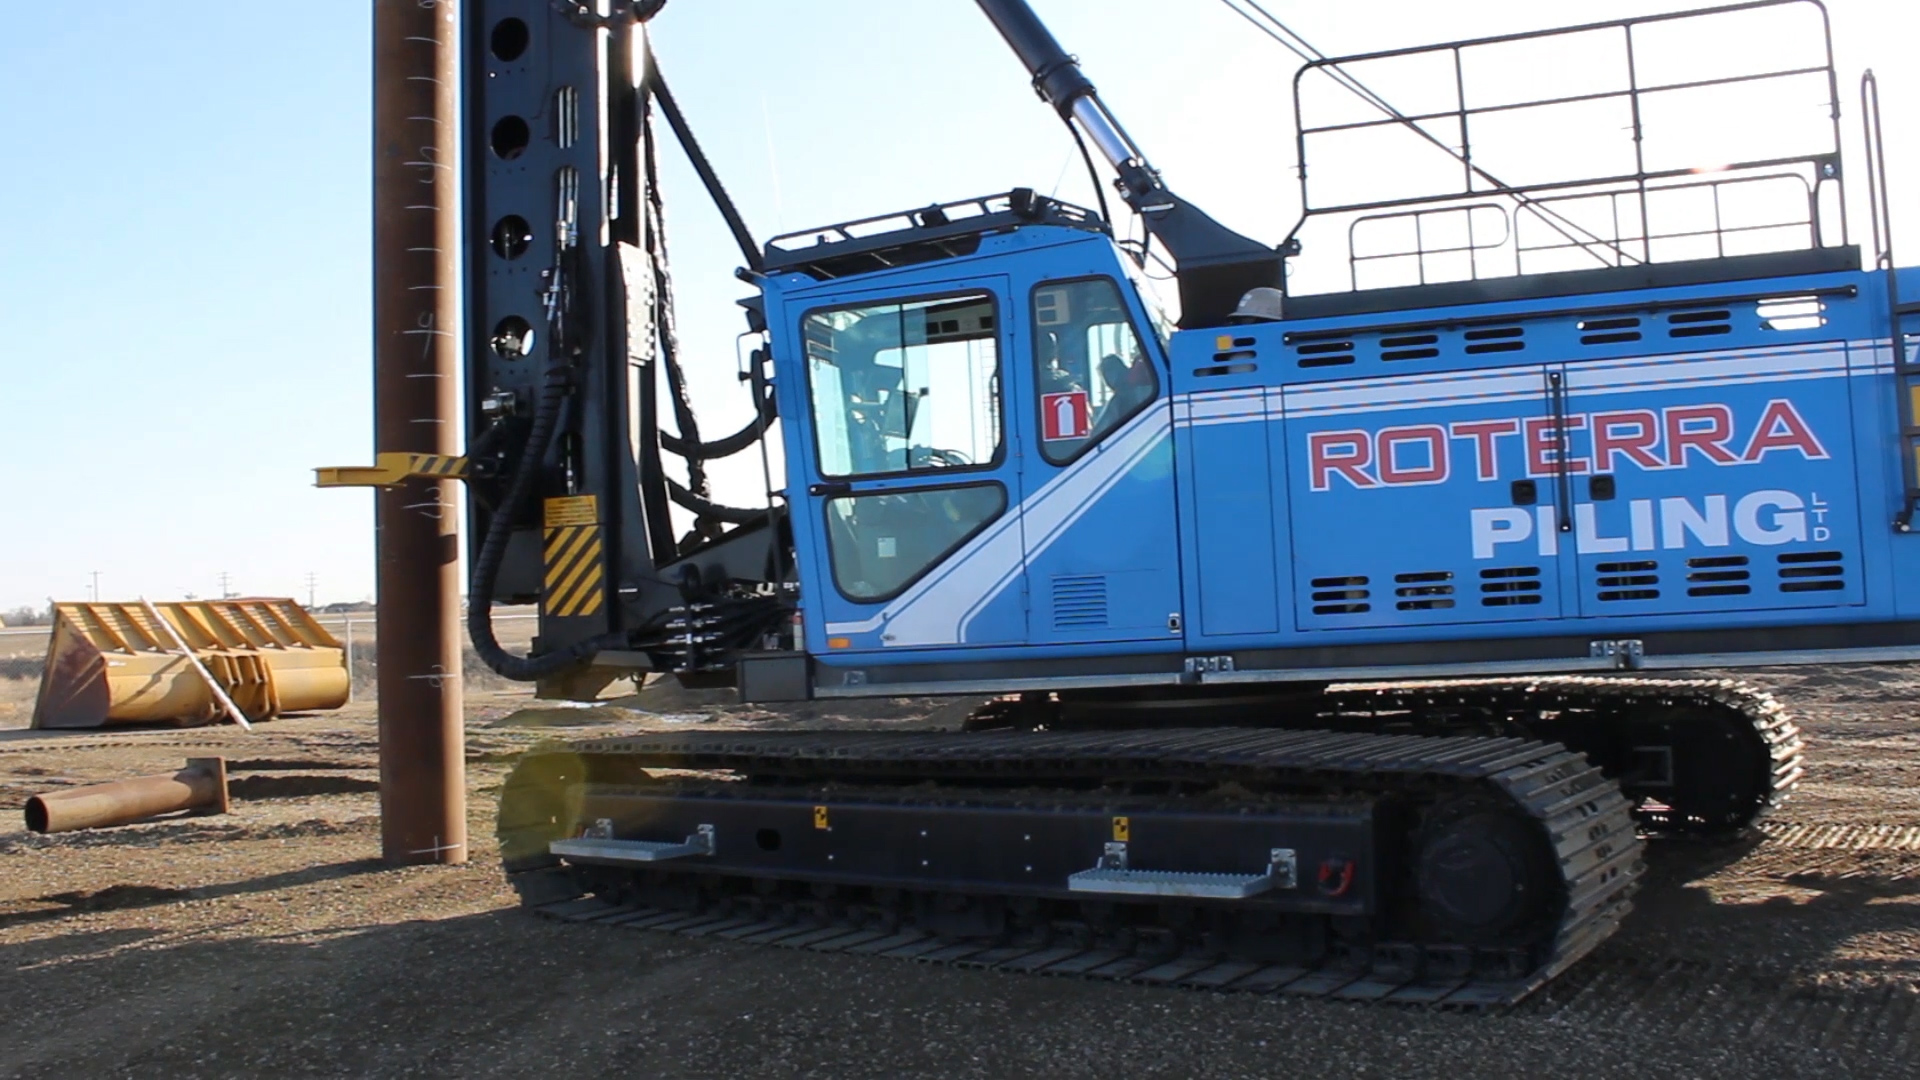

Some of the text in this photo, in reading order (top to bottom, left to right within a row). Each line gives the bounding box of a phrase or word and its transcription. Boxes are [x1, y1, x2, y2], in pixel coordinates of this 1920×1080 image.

[1307, 399, 1830, 492] ROTERRA
[1471, 490, 1807, 559] PILING
[1811, 492, 1830, 541] LTD
